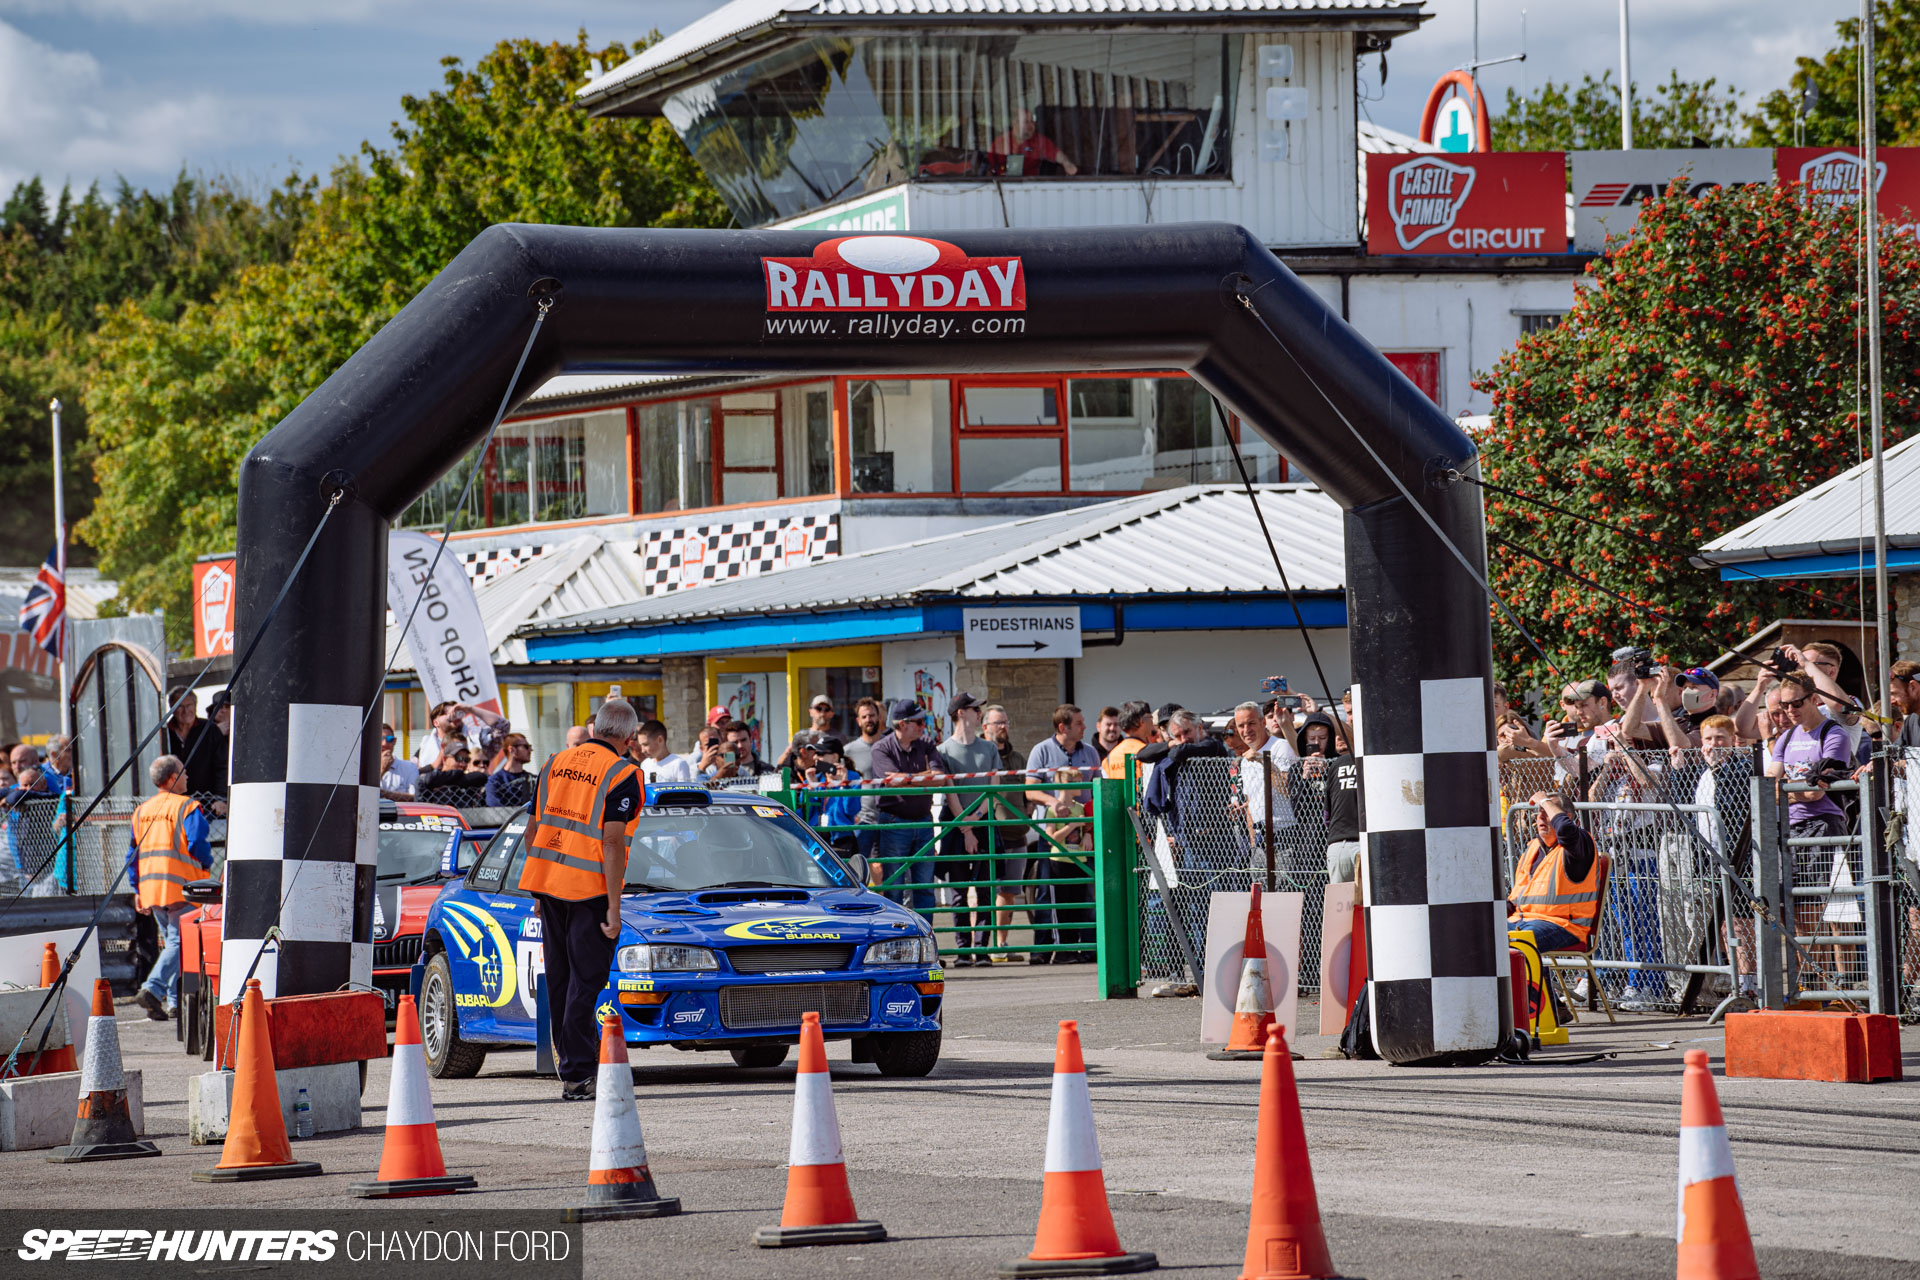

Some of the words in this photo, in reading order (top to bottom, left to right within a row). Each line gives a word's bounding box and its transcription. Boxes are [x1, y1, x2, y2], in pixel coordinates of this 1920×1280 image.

[1401, 168, 1455, 195] CASTLE
[1402, 198, 1453, 226] COMBE
[1448, 228, 1545, 249] CIRCUIT
[766, 259, 1019, 308] RALLYDAY
[970, 617, 1075, 632] PEDESTRIANS
[552, 768, 598, 786] MARSHAL
[478, 867, 501, 881] SUBARU
[785, 933, 841, 941] SUBARU
[618, 979, 655, 991] PIRELLI
